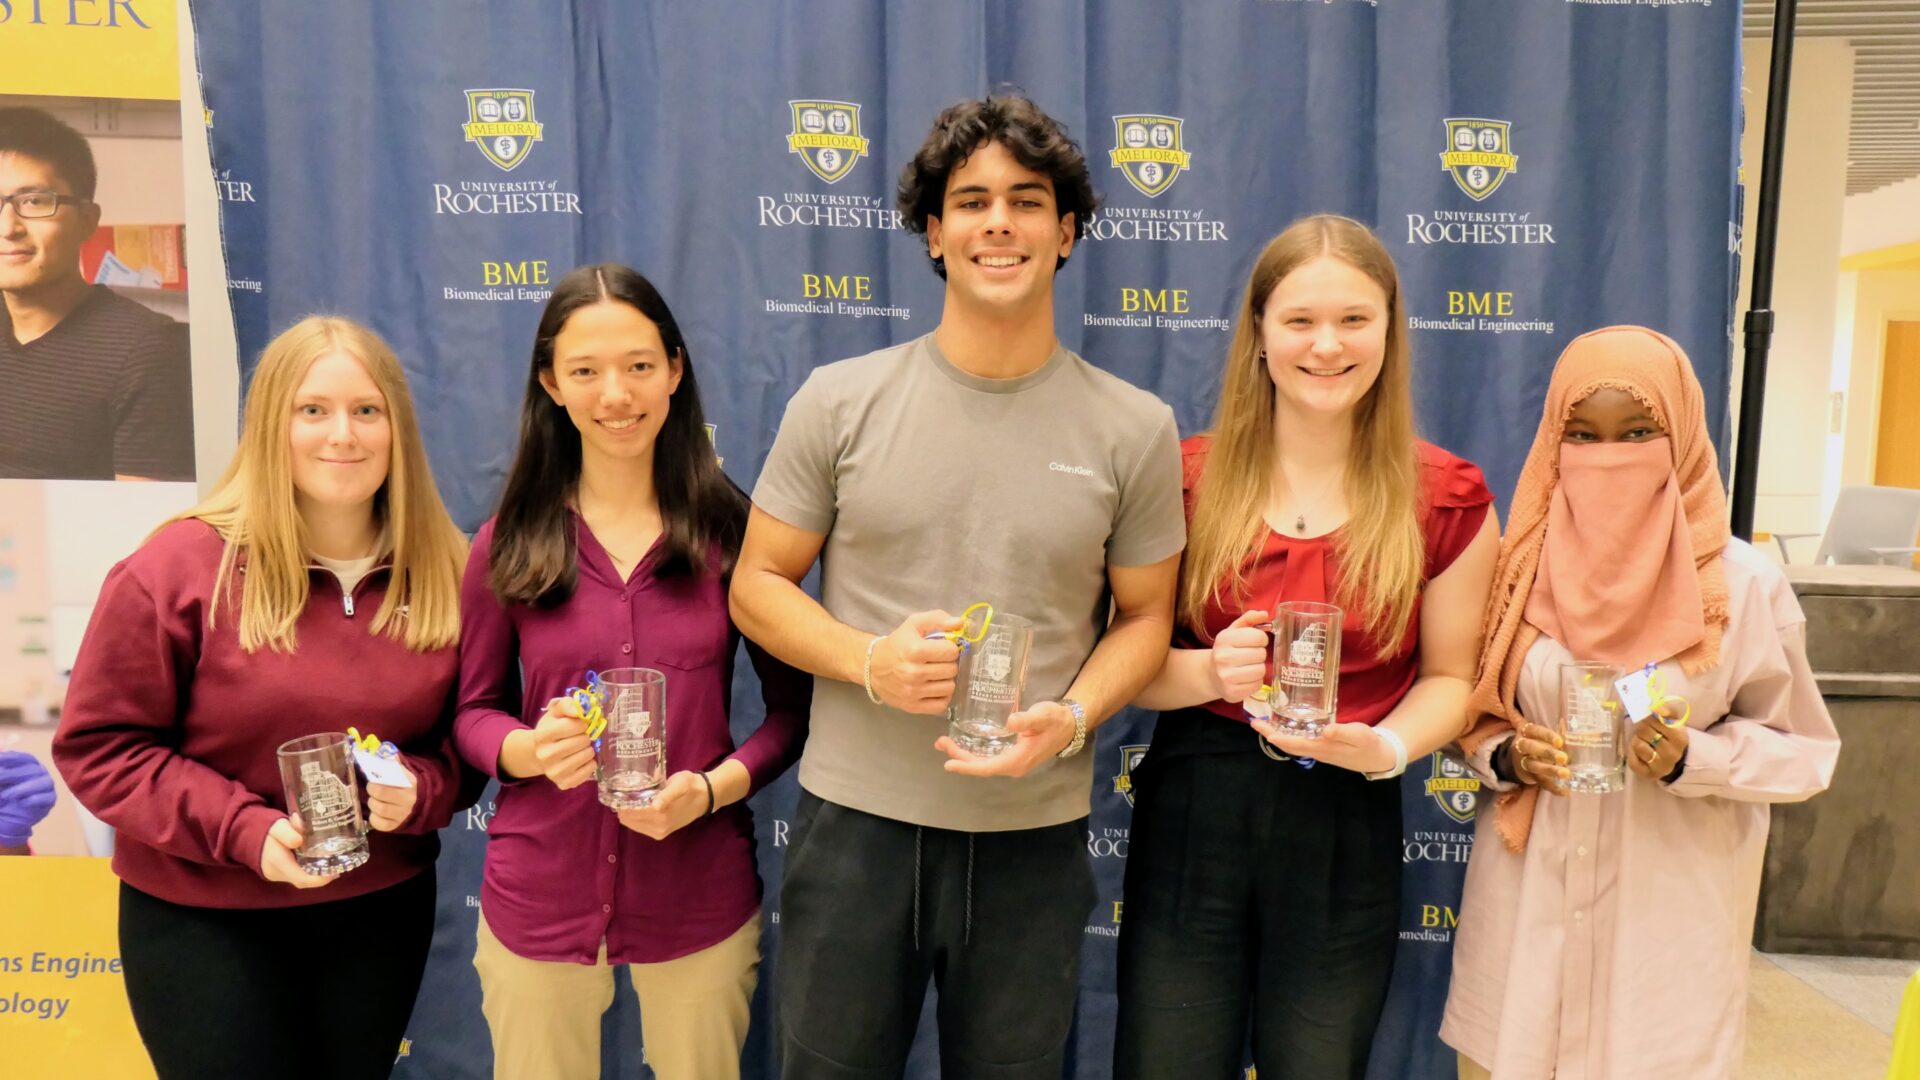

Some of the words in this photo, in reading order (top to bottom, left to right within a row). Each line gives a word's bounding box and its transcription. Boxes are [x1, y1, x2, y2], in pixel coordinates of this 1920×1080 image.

[474, 123, 533, 135] MELIORA
[798, 134, 859, 149] MELIORA
[1120, 150, 1180, 163] MELIORA
[1450, 153, 1507, 165] MELIORA
[461, 181, 545, 192] UNIVERSITY
[548, 180, 558, 191] of
[433, 184, 583, 215] ROCHESTER
[784, 193, 871, 206] UNIVERSITY
[873, 197, 883, 207] of
[758, 196, 904, 230] ROCHESTER
[1105, 207, 1190, 220] UNIVERSITY
[1193, 209, 1204, 220] of
[1434, 210, 1516, 222] UNIVERSITY
[1519, 212, 1530, 223] of
[1082, 213, 1229, 241] ROCHESTER
[1406, 214, 1557, 244] ROCHESTER
[482, 261, 550, 286] BME
[227, 277, 263, 293] eering
[802, 274, 872, 300] BME
[444, 287, 514, 301] Biomedical
[518, 287, 553, 302] Engin
[1121, 288, 1190, 313] BME
[766, 300, 834, 314] Biomedical
[838, 302, 910, 319] Engineering
[1448, 291, 1513, 316] BME
[1084, 314, 1152, 327] Biomedical
[1156, 315, 1229, 331] Engineering
[1408, 317, 1475, 330] Biomedical
[1479, 318, 1554, 334] Engineering
[1403, 839, 1473, 863] OCHE
